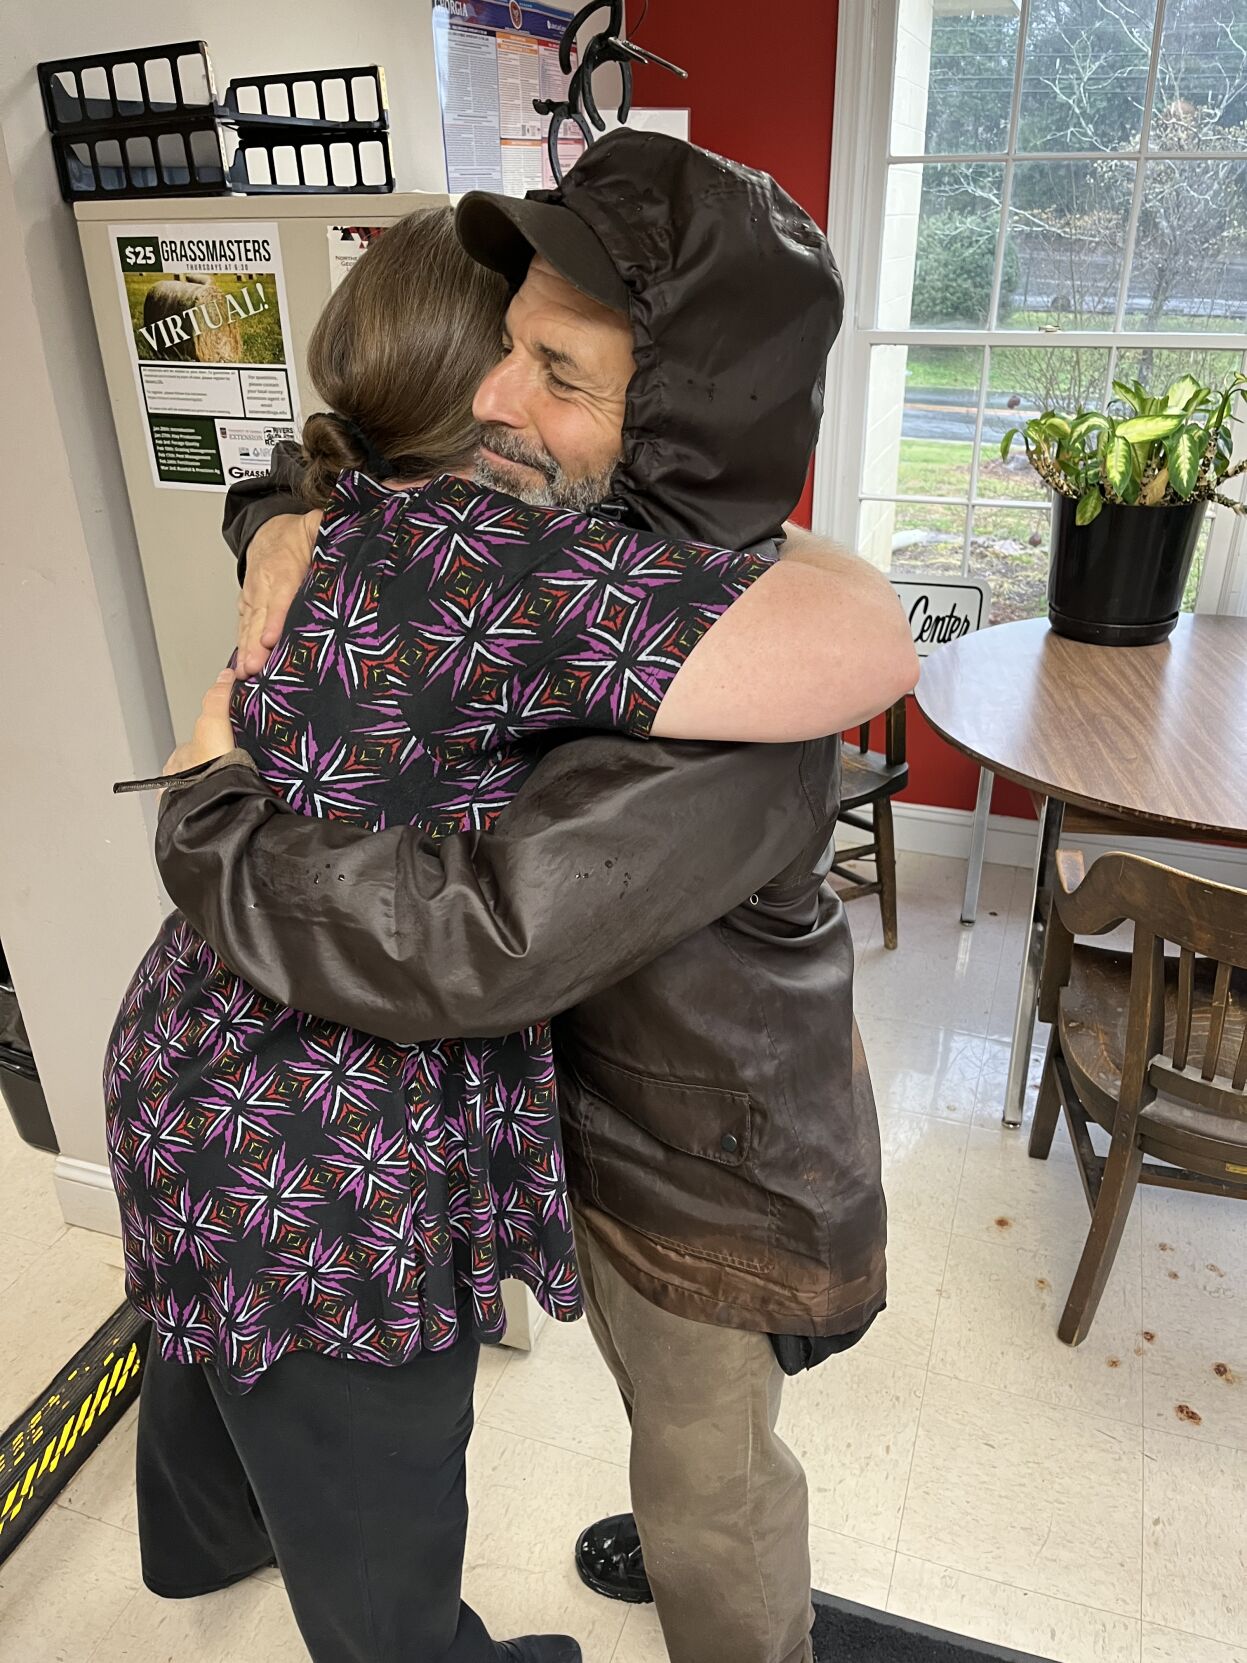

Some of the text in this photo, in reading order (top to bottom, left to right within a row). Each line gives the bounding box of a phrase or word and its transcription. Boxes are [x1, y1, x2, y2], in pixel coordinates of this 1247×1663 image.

[125, 245, 156, 265] $25
[160, 239, 271, 262] GRASSMASTERS
[186, 263, 222, 271] THURSDAYS
[138, 282, 269, 352] VIRTUAL!
[908, 595, 971, 643] Center
